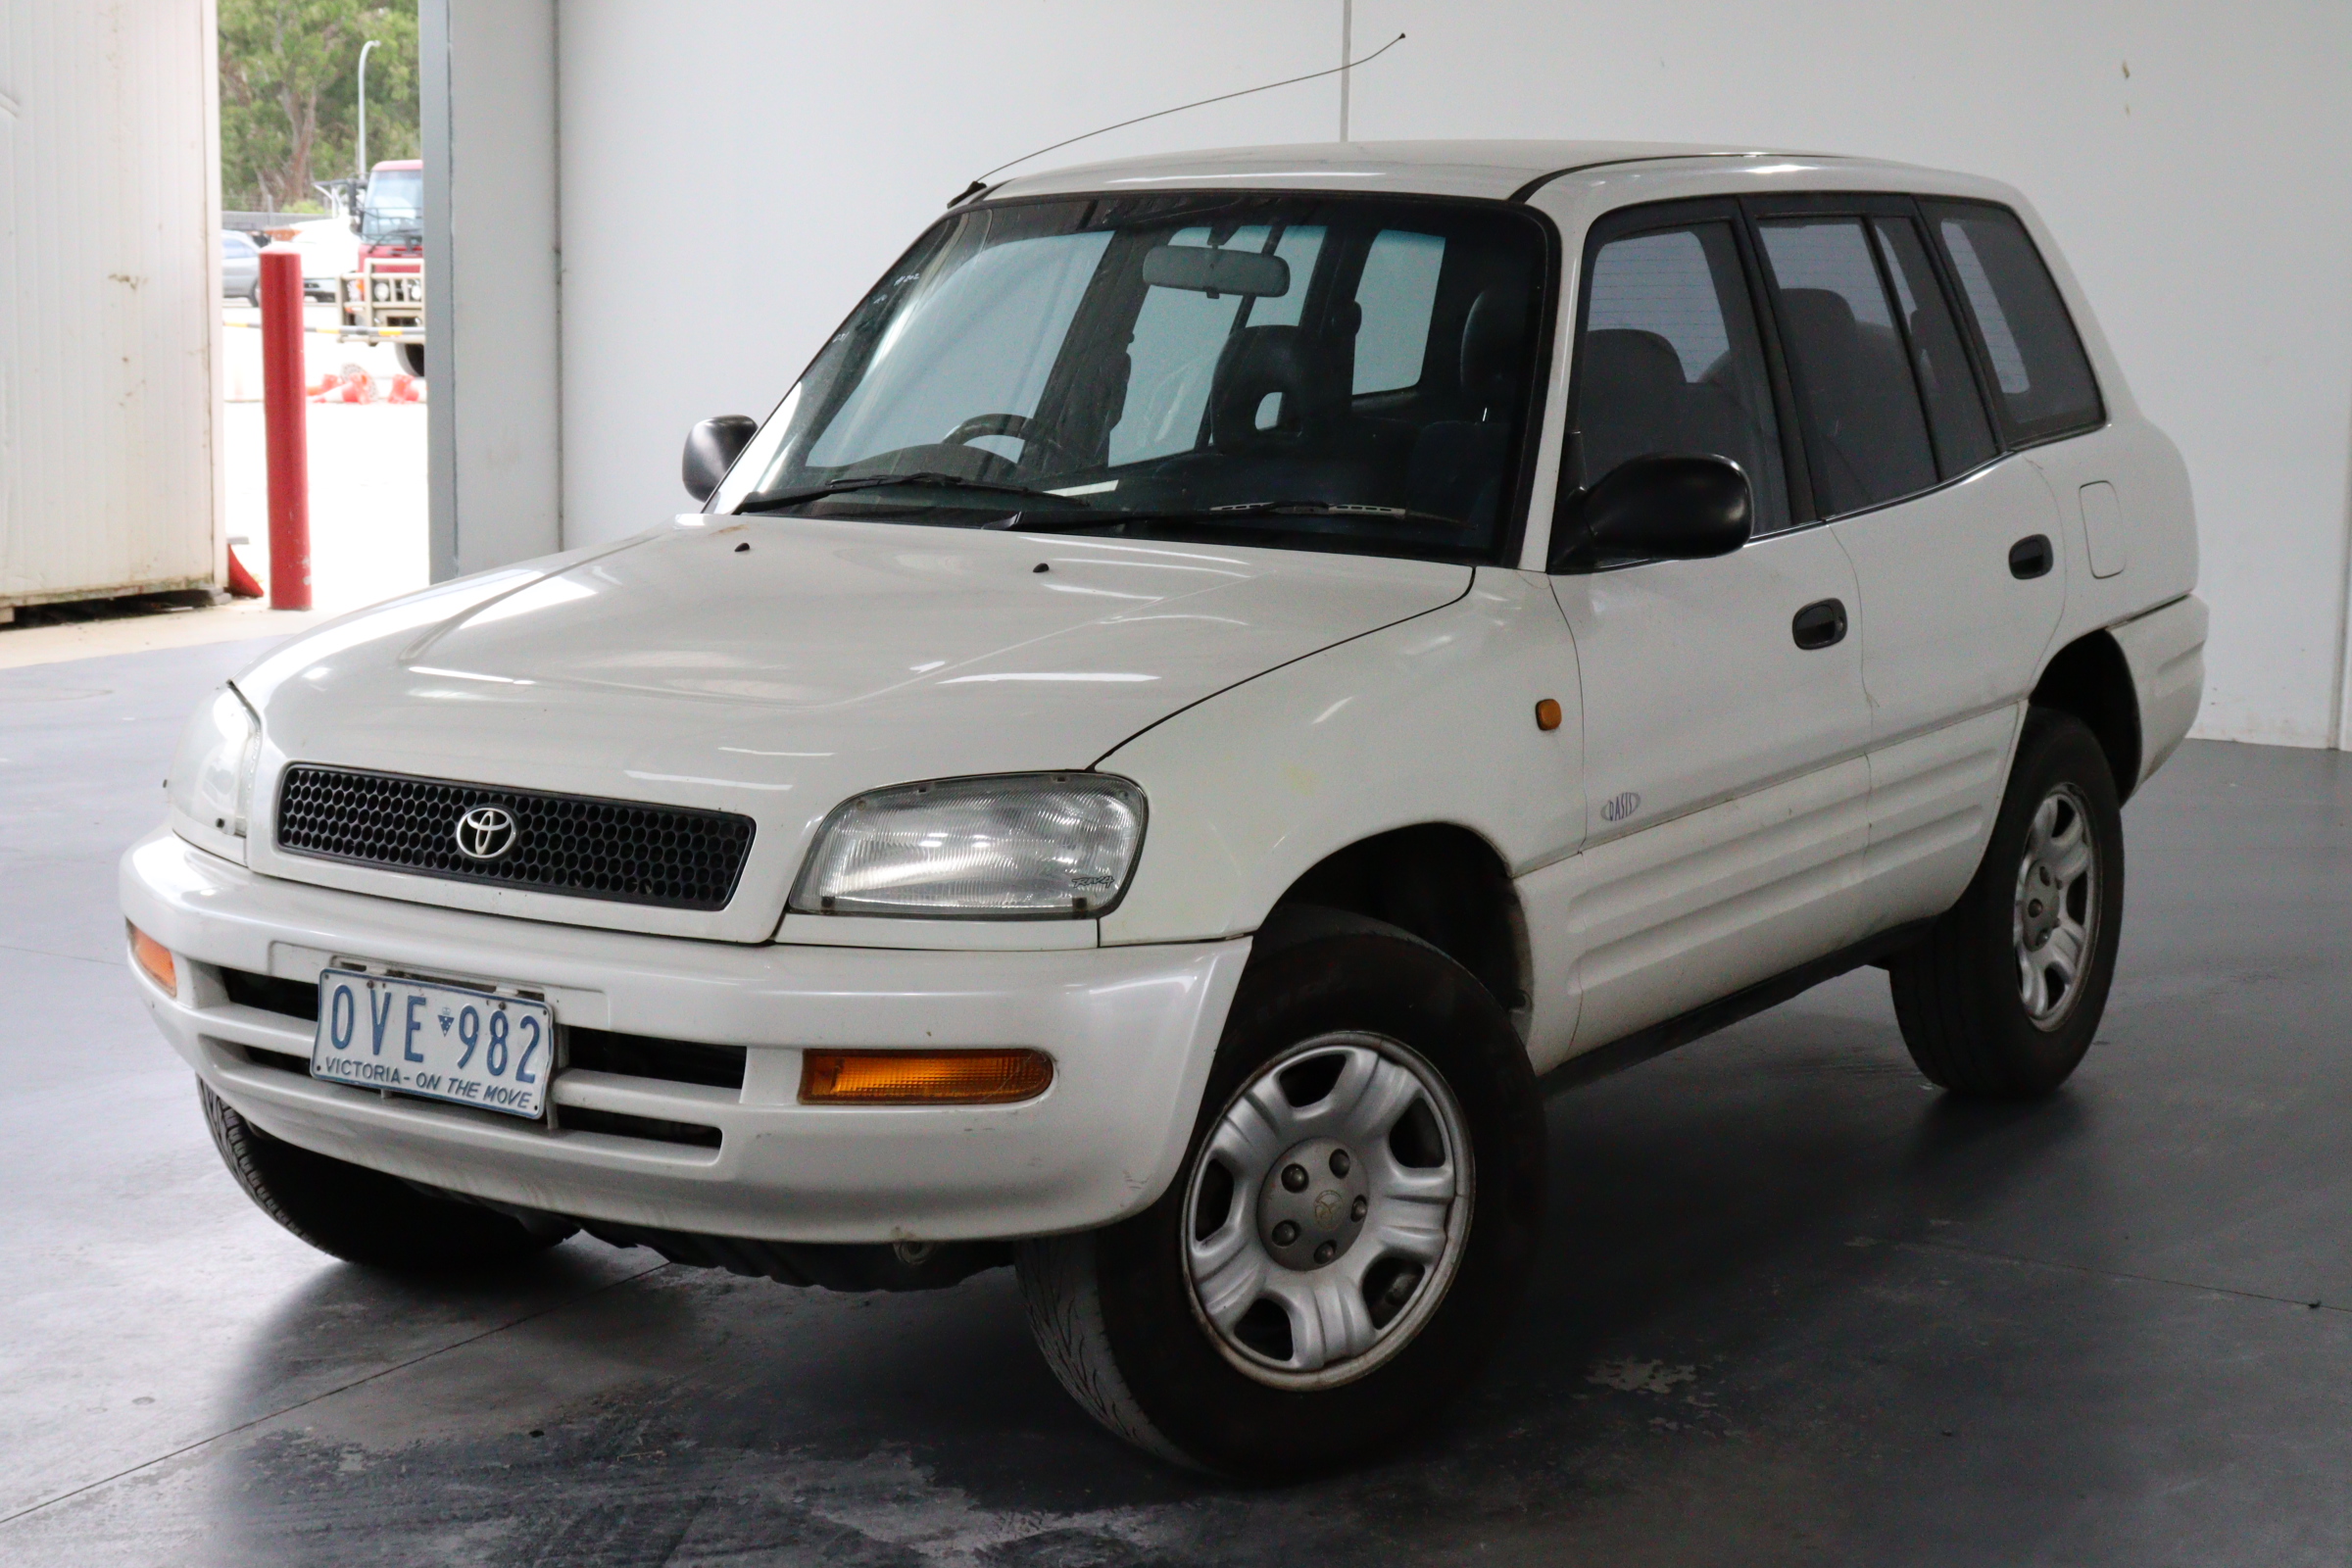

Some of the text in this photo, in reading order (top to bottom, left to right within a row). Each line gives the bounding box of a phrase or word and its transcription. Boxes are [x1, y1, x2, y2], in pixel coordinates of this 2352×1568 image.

[1071, 875, 1115, 889] RAV4
[330, 984, 540, 1084] OVE 982
[416, 1072, 441, 1091] ON
[447, 1078, 481, 1098] THE
[482, 1089, 532, 1108] MOVE
